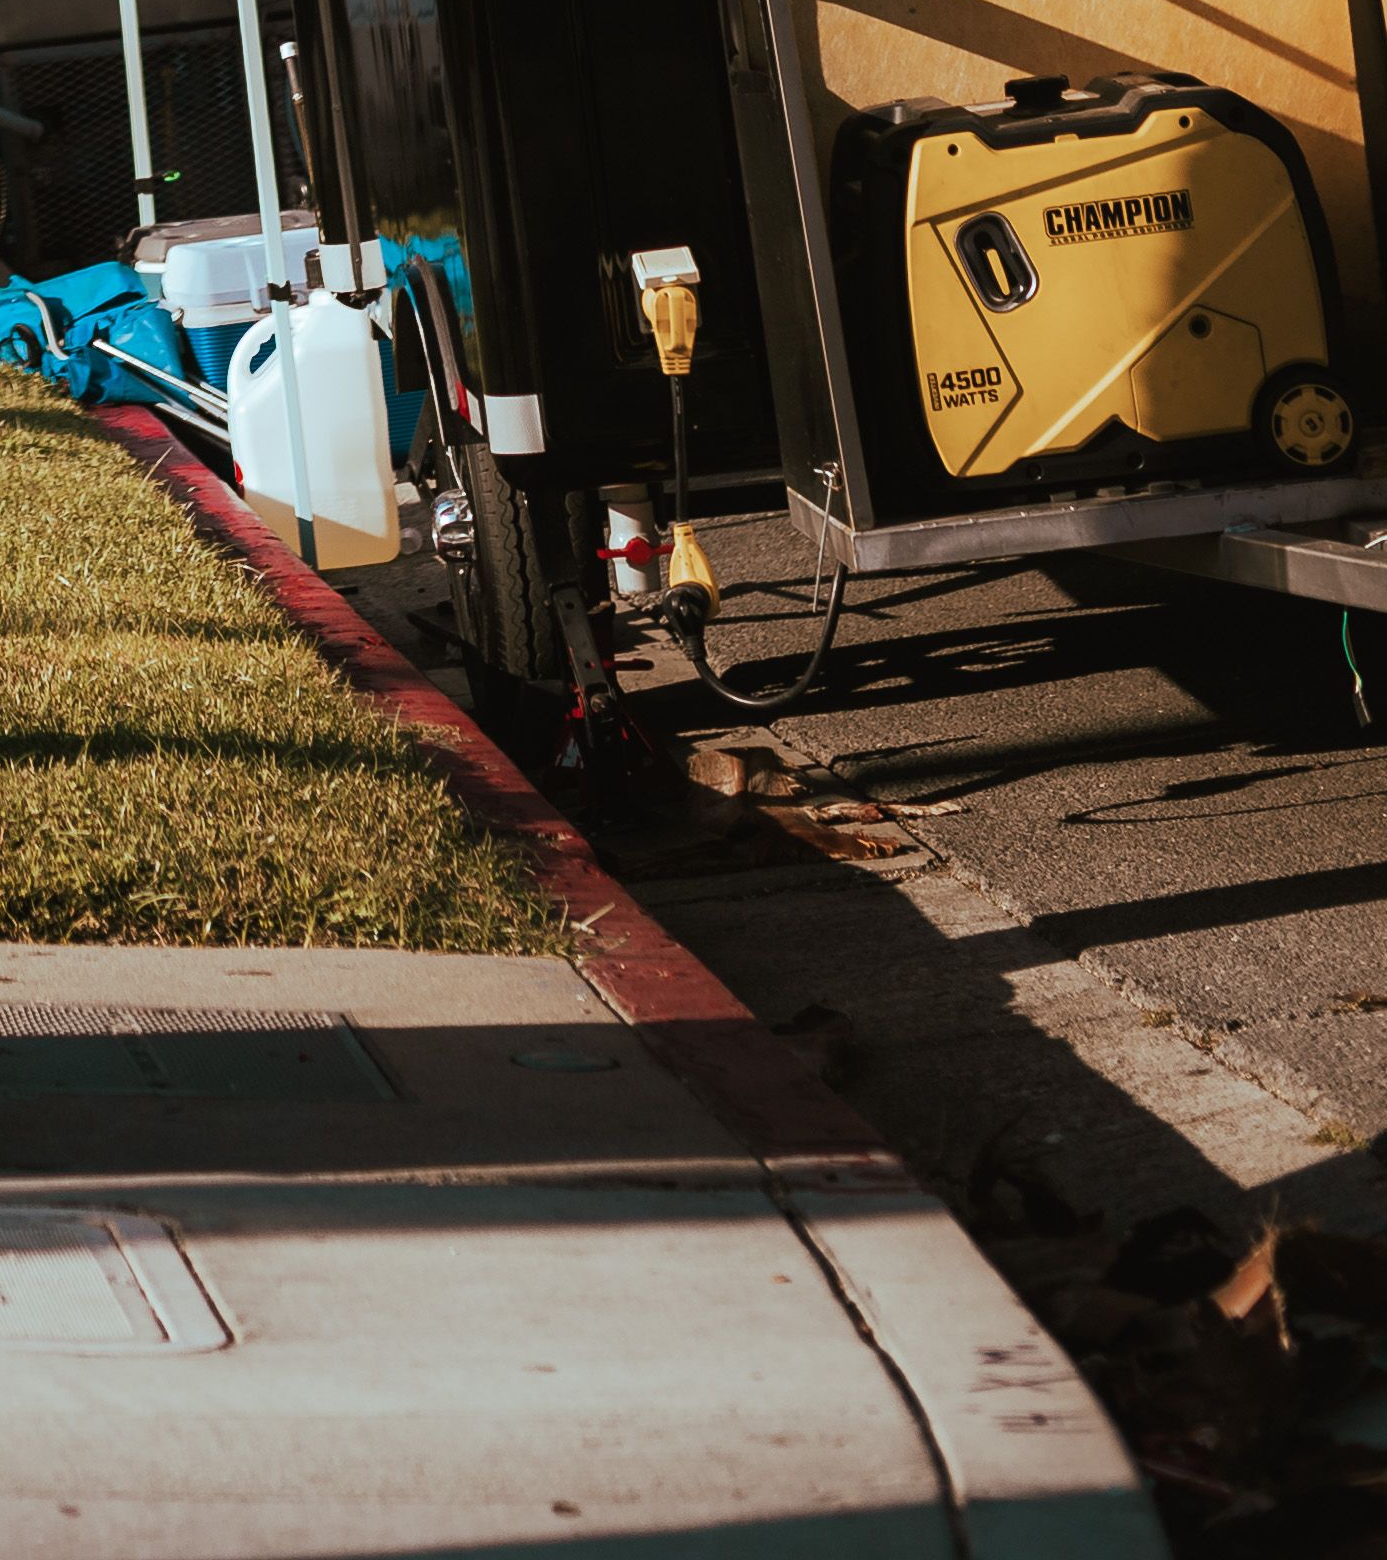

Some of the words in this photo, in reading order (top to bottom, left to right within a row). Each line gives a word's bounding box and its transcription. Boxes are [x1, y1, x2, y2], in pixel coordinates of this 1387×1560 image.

[1045, 191, 1191, 236] CHAMPION
[940, 367, 1002, 392] 4500
[943, 388, 1000, 409] WATTS
